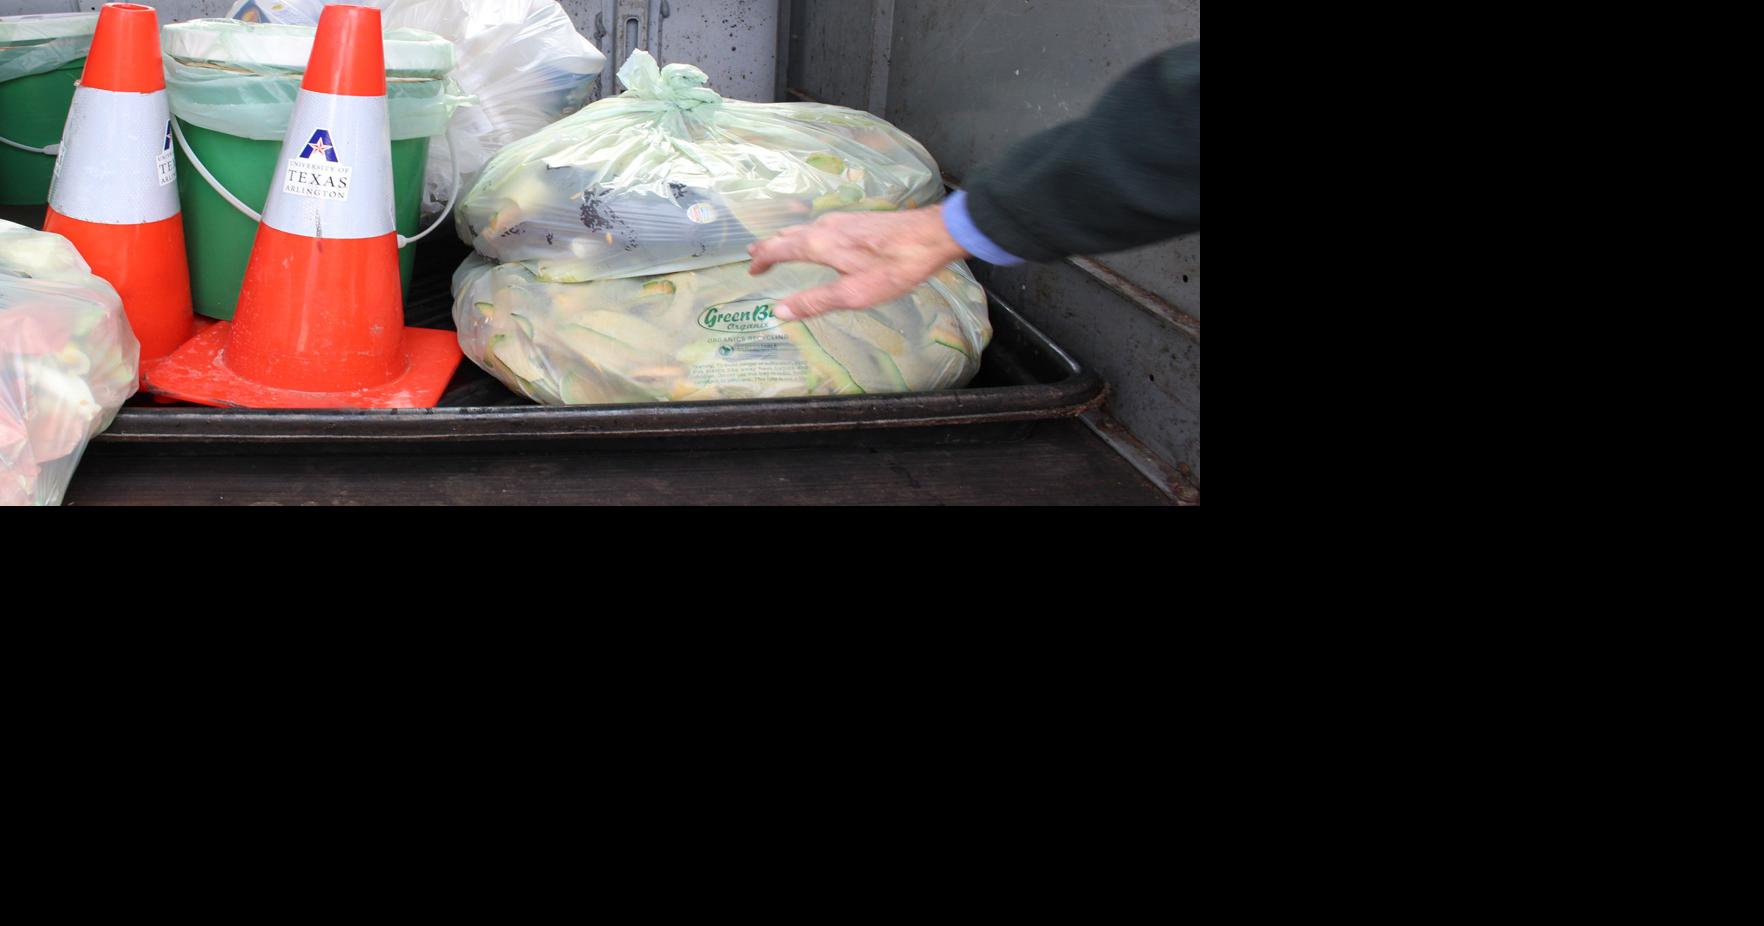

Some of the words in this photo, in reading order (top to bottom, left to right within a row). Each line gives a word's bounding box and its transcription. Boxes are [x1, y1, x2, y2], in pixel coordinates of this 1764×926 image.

[290, 160, 335, 172] UNIVERSITY
[288, 169, 348, 189] TEXAS
[285, 185, 345, 199] ARLINGTON
[707, 336, 746, 344] ORGANICS
